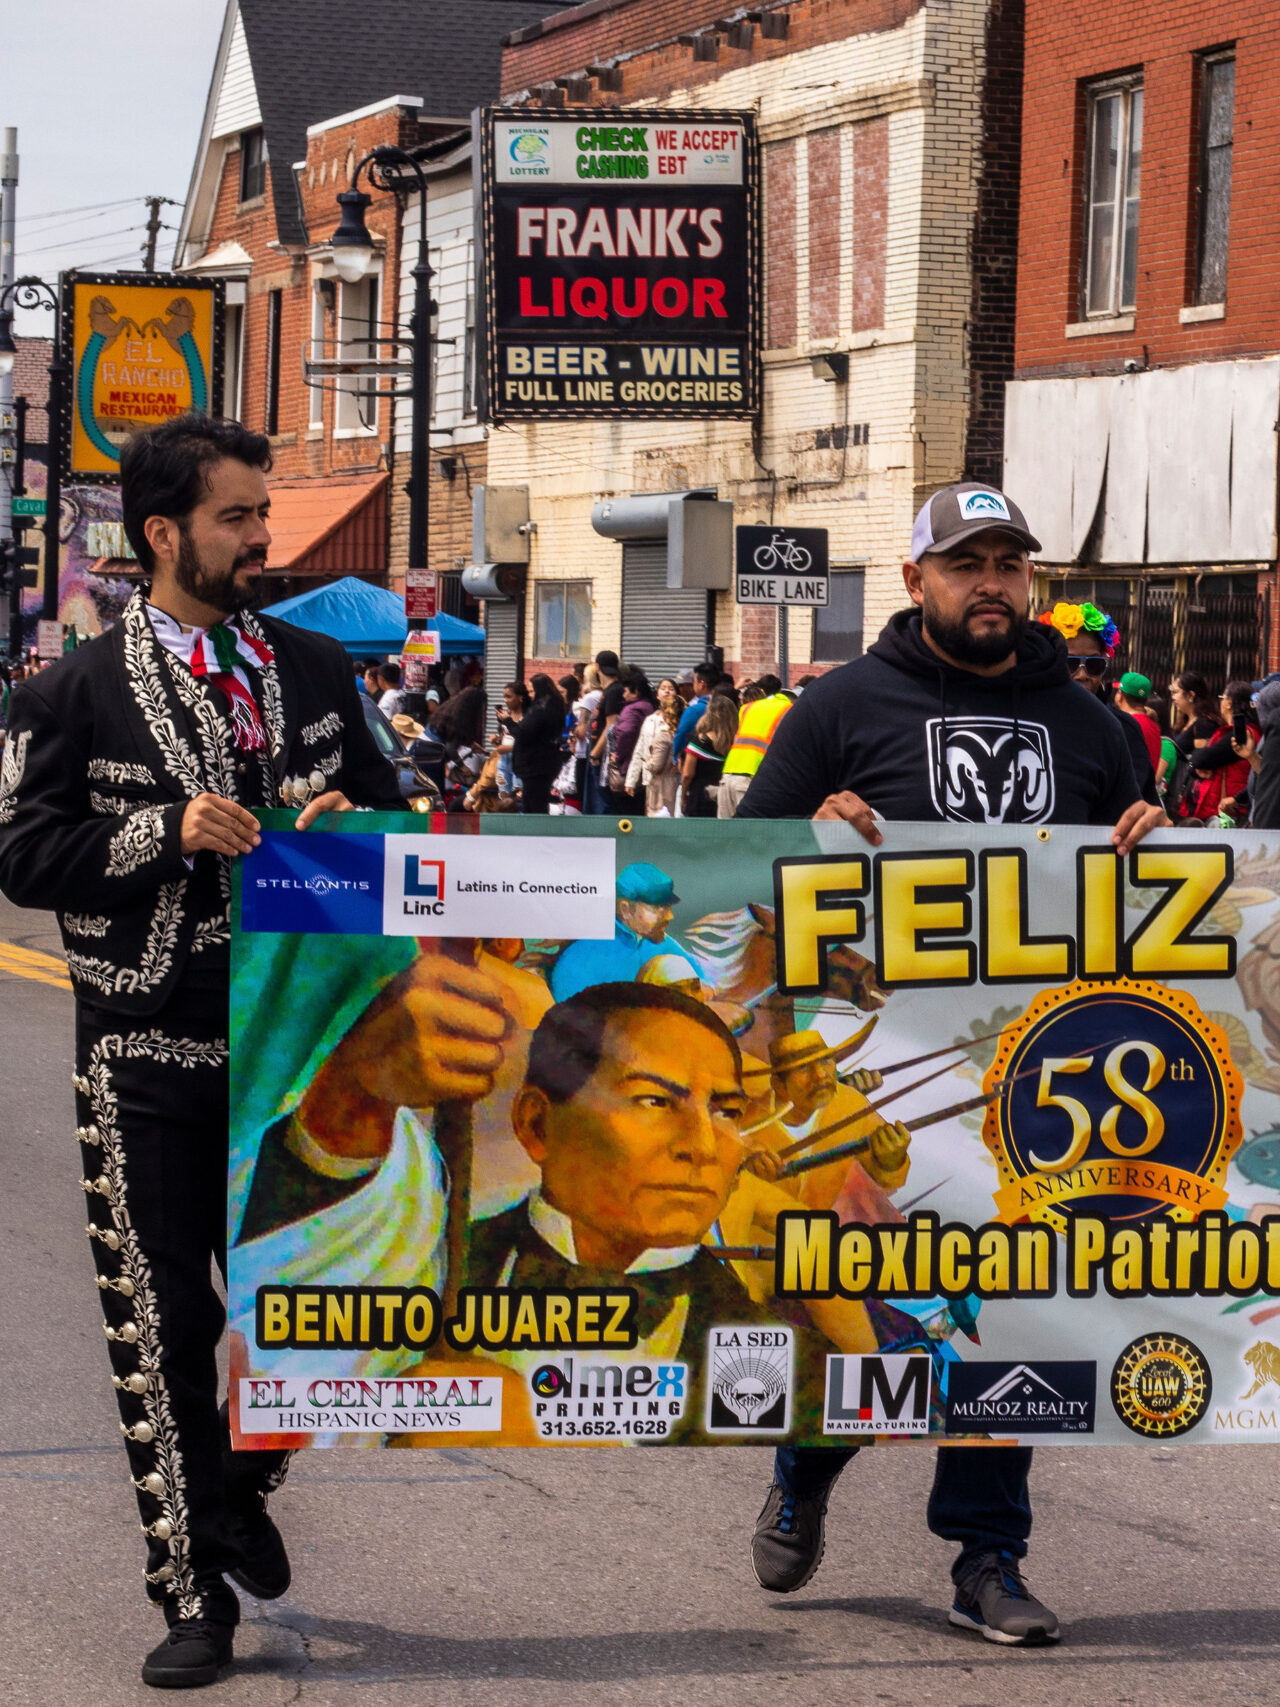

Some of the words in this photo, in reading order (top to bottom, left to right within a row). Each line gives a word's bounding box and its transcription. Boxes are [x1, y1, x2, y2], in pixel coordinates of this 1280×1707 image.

[576, 127, 648, 151] CHECK
[655, 130, 677, 150] WE
[682, 130, 738, 150] ACCEPT
[509, 167, 550, 175] LOTTERY
[576, 155, 648, 179] CASHING
[658, 155, 687, 175] EBT
[517, 207, 723, 259] FRANK'S
[518, 276, 728, 321] LIQUOR
[125, 340, 163, 363] EL
[506, 346, 608, 376] BEER
[640, 347, 741, 376] WINE
[102, 362, 185, 388] RANCHO
[109, 391, 177, 405] MEXICAN
[505, 381, 559, 401] FULL
[565, 381, 614, 401] LINE
[620, 381, 743, 402] GROCERIES
[100, 402, 185, 416] RESTAURANT
[741, 580, 776, 599] BIKE
[785, 581, 825, 600] LANE
[256, 878, 370, 891] STELLANTIS
[457, 881, 498, 894] Latins
[502, 881, 515, 894] in
[518, 881, 598, 895] Connection
[403, 901, 445, 916] LinC
[774, 846, 1236, 993] FELIZ
[1020, 1167, 1210, 1207] ANNIVERSARY
[777, 1212, 1056, 1298] Mexican
[260, 1289, 438, 1346] BENITO
[449, 1290, 634, 1346] JUAREZ
[715, 1332, 743, 1347] LA
[747, 1332, 788, 1347] SED
[248, 1380, 296, 1409] EL
[307, 1378, 493, 1408] CENTRAL
[1142, 1376, 1180, 1397] UAW
[536, 1402, 680, 1417] PRINTING
[952, 1401, 1021, 1416] MUNOZ
[1027, 1401, 1088, 1415] REALTY
[278, 1412, 390, 1428] HISPANIC
[393, 1412, 461, 1427] NEWS
[542, 1420, 667, 1436] 313.652.1628
[827, 1421, 928, 1431] MANUFACTURING
[1214, 1409, 1278, 1429] MGM
